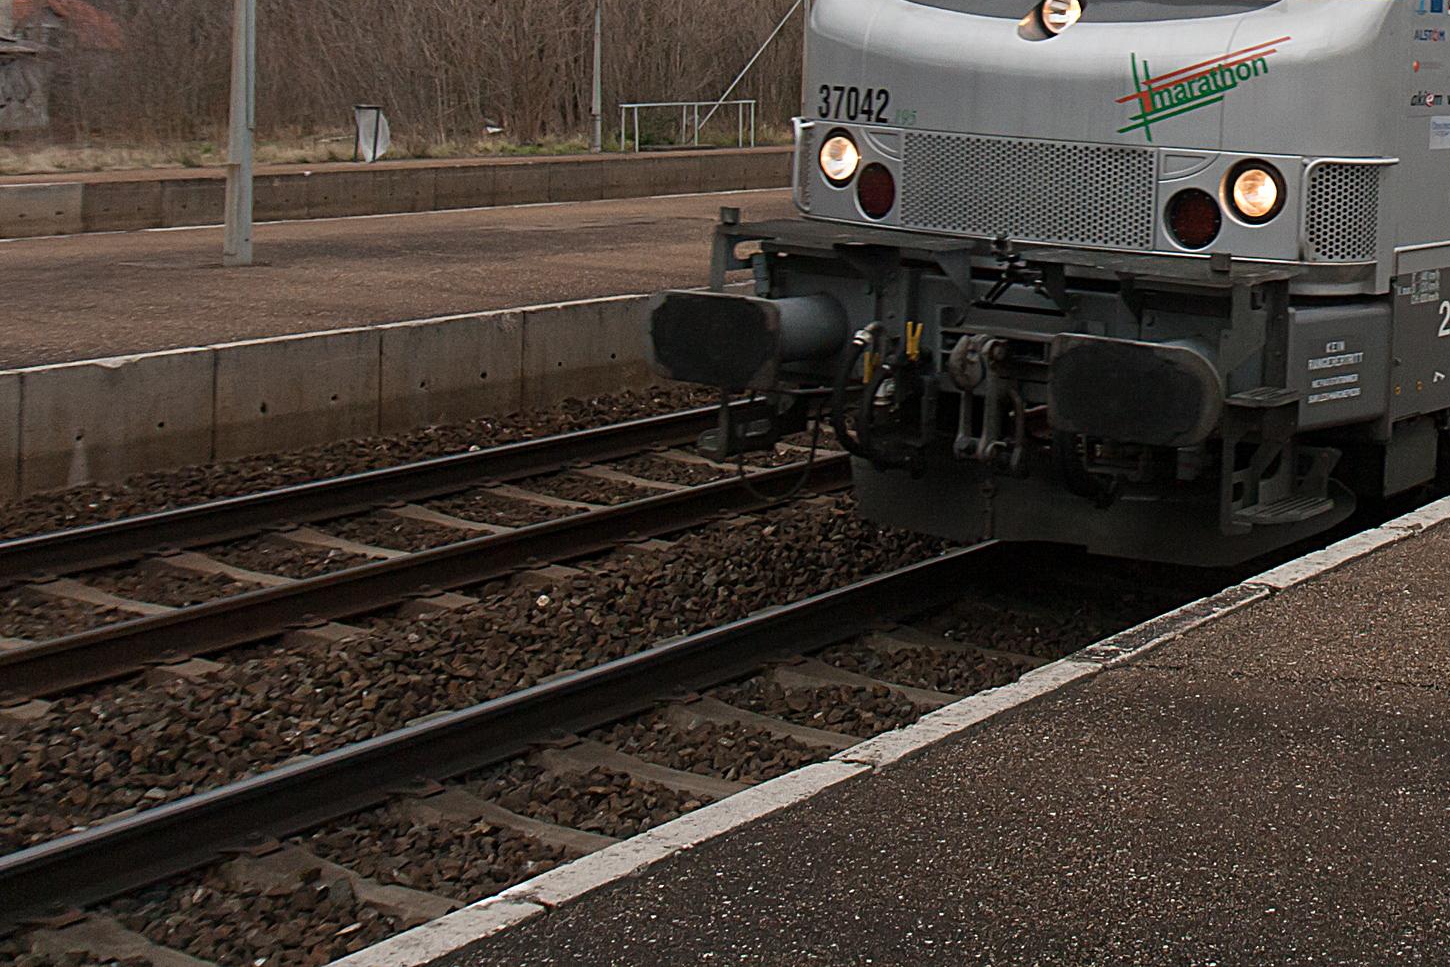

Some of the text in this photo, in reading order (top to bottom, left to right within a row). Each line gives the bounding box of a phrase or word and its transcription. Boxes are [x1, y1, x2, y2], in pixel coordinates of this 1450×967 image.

[1414, 28, 1446, 42] ALSTOM
[1150, 56, 1269, 111] marathon
[818, 84, 890, 124] 37042
